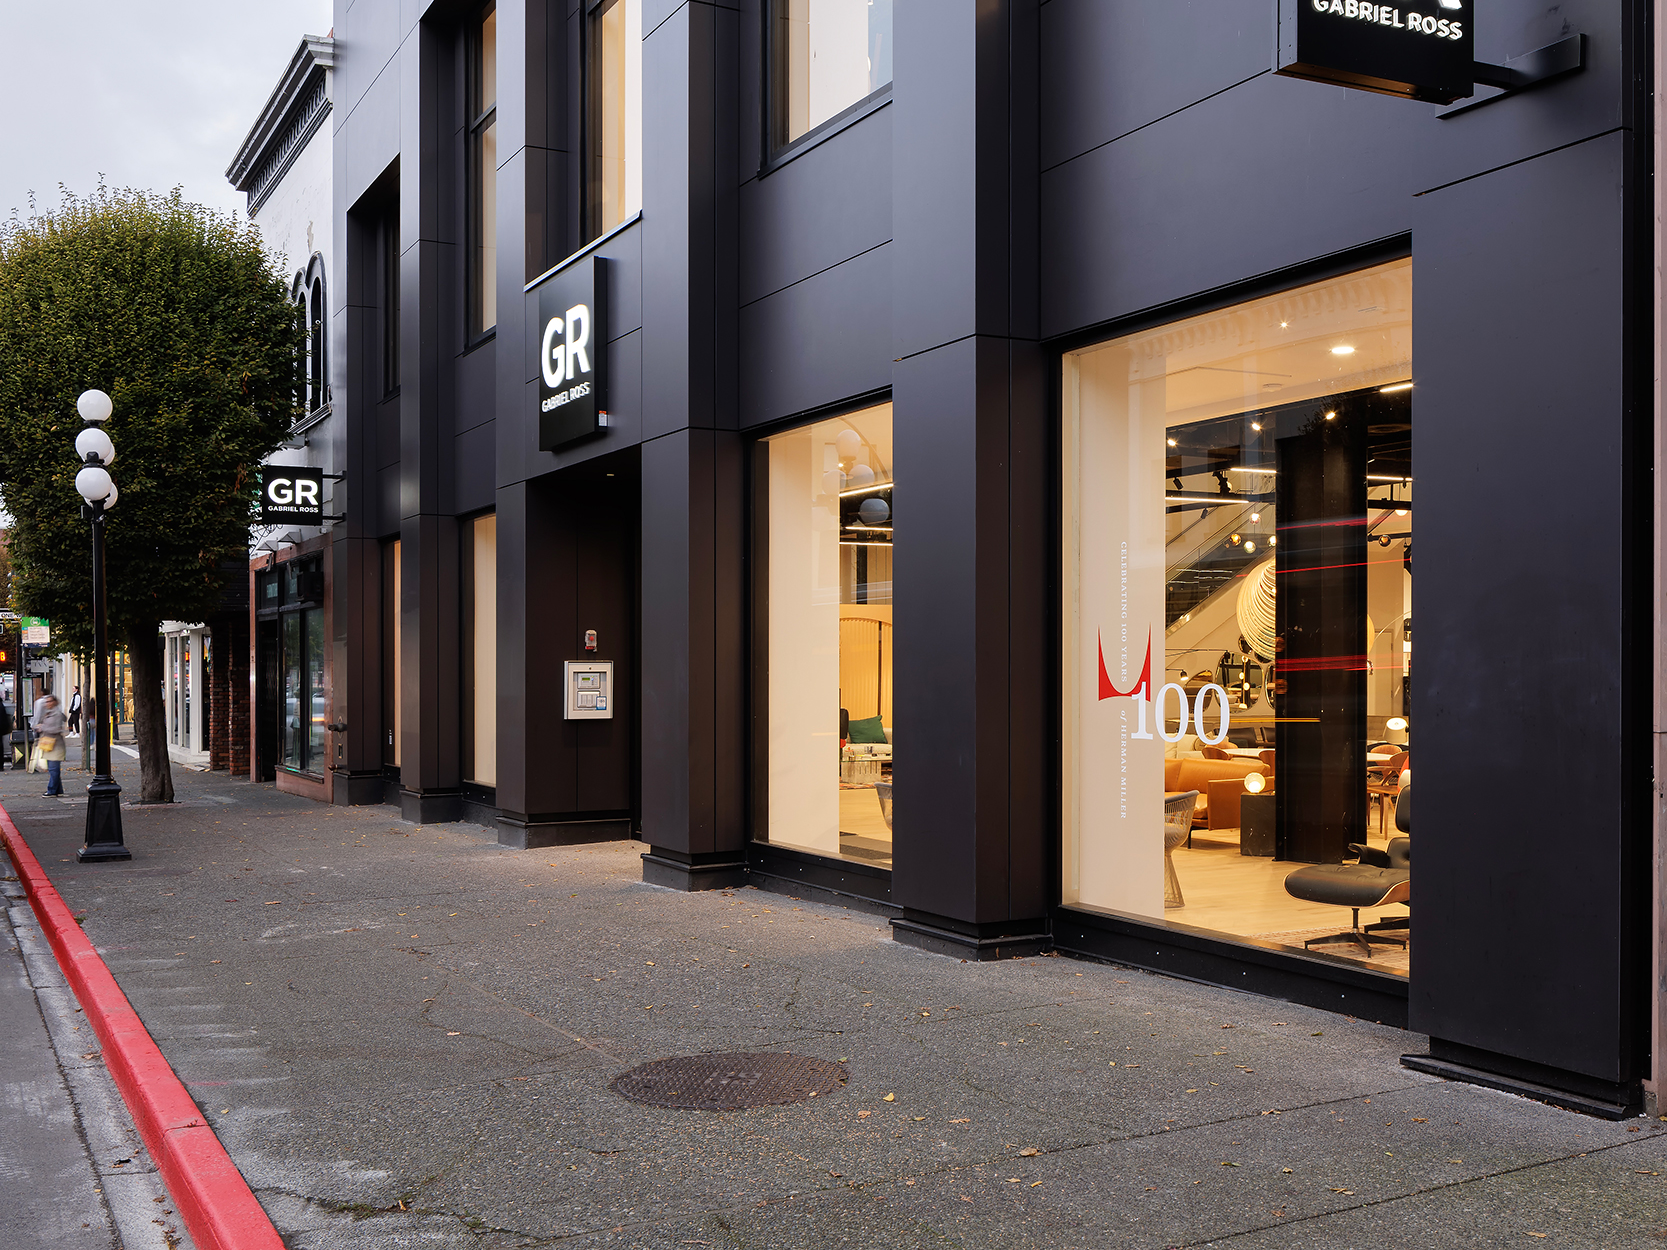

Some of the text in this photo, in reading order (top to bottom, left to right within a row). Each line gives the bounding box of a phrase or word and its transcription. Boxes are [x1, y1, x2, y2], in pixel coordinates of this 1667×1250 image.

[1407, 11, 1463, 41] ROSS
[541, 304, 591, 388] GR
[541, 381, 591, 413] GABRIEL ROSS
[268, 478, 318, 505] GR
[1120, 541, 1128, 619] CELEBRATING
[1120, 623, 1128, 642] 100
[1120, 646, 1128, 682] YEARS
[1131, 681, 1230, 745] 100
[1120, 725, 1128, 773] HERMAN
